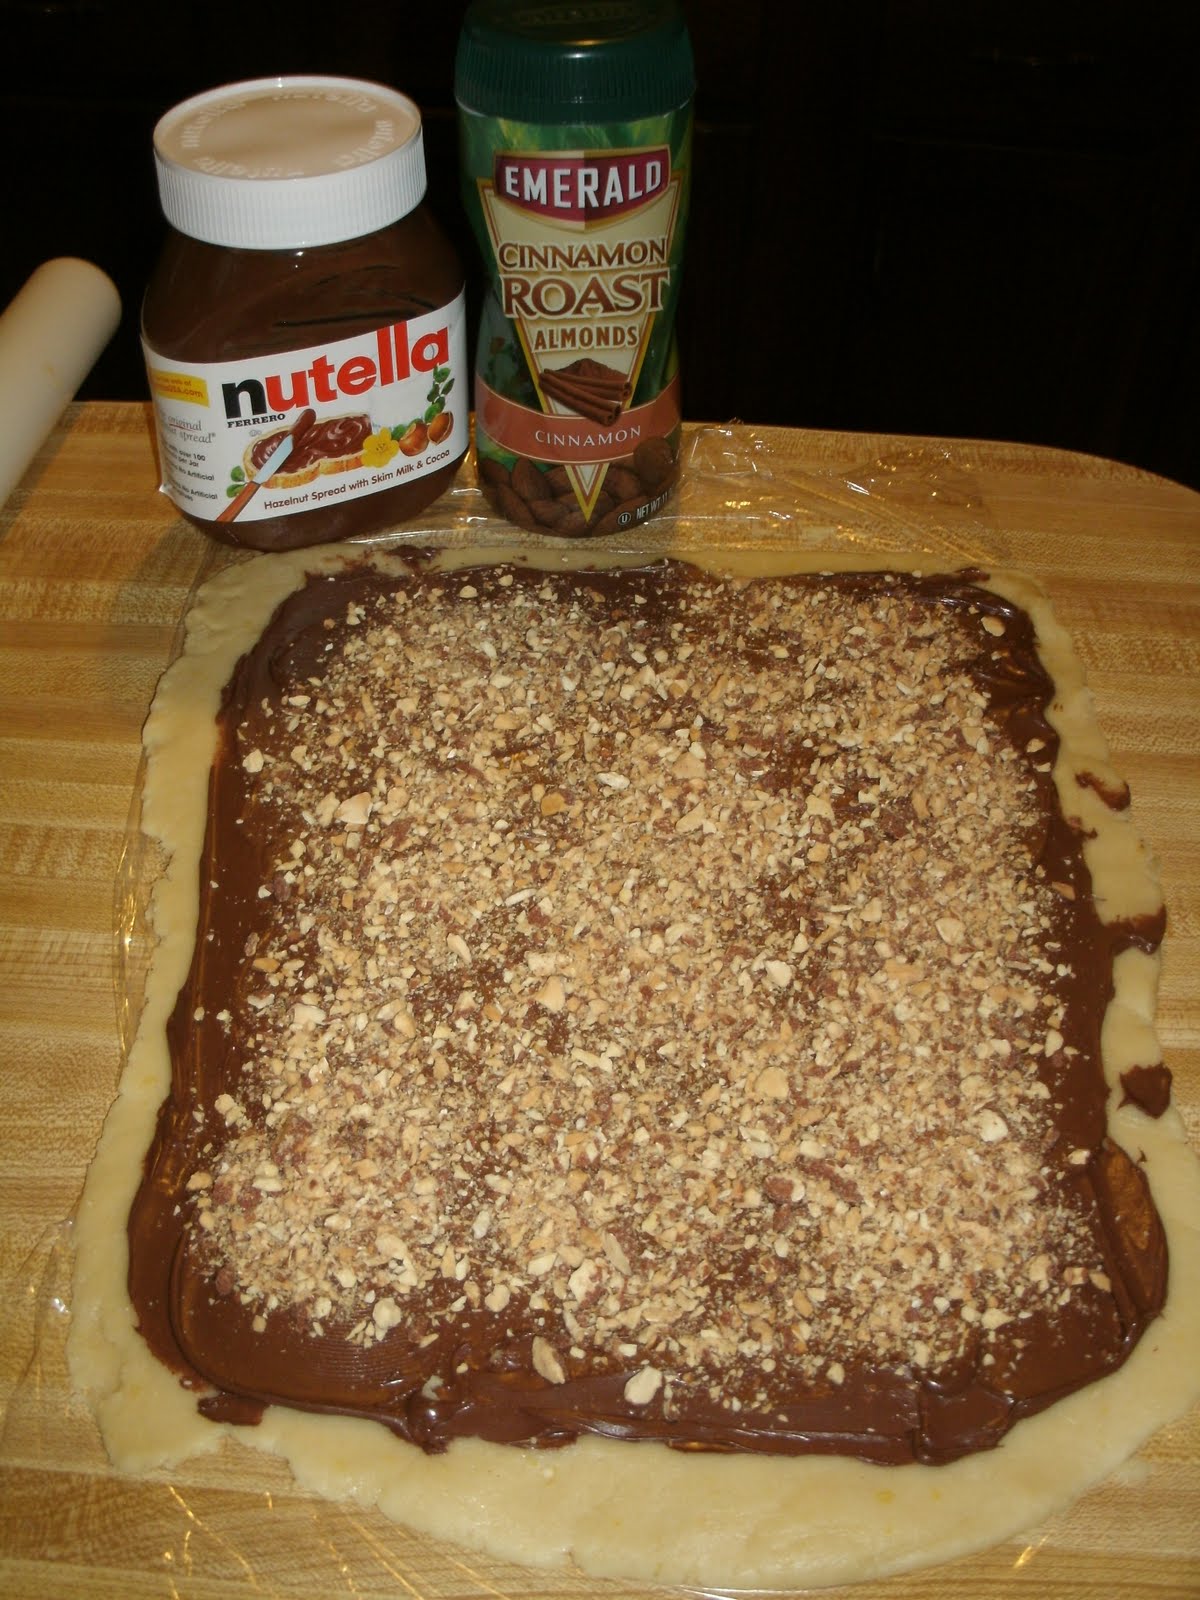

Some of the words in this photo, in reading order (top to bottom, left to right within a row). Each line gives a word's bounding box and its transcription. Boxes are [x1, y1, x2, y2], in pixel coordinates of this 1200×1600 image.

[505, 160, 662, 209] EMERALD
[500, 238, 666, 270] CINNAMON
[502, 270, 670, 316] ROAST
[534, 325, 638, 350] ALMONDS
[221, 320, 449, 420] nutella
[227, 413, 286, 429] FERRERO
[534, 425, 642, 447] CINNAMON
[193, 453, 206, 461] 100
[187, 469, 215, 481] Artificial
[264, 493, 310, 511] Hazelnut
[311, 484, 347, 502] Spread
[348, 478, 370, 492] with
[371, 470, 394, 485] Skim
[395, 462, 415, 479] Milk
[416, 459, 423, 469] &
[425, 448, 451, 466] Cocoa
[190, 488, 218, 500] Artificial
[636, 503, 650, 520] NET
